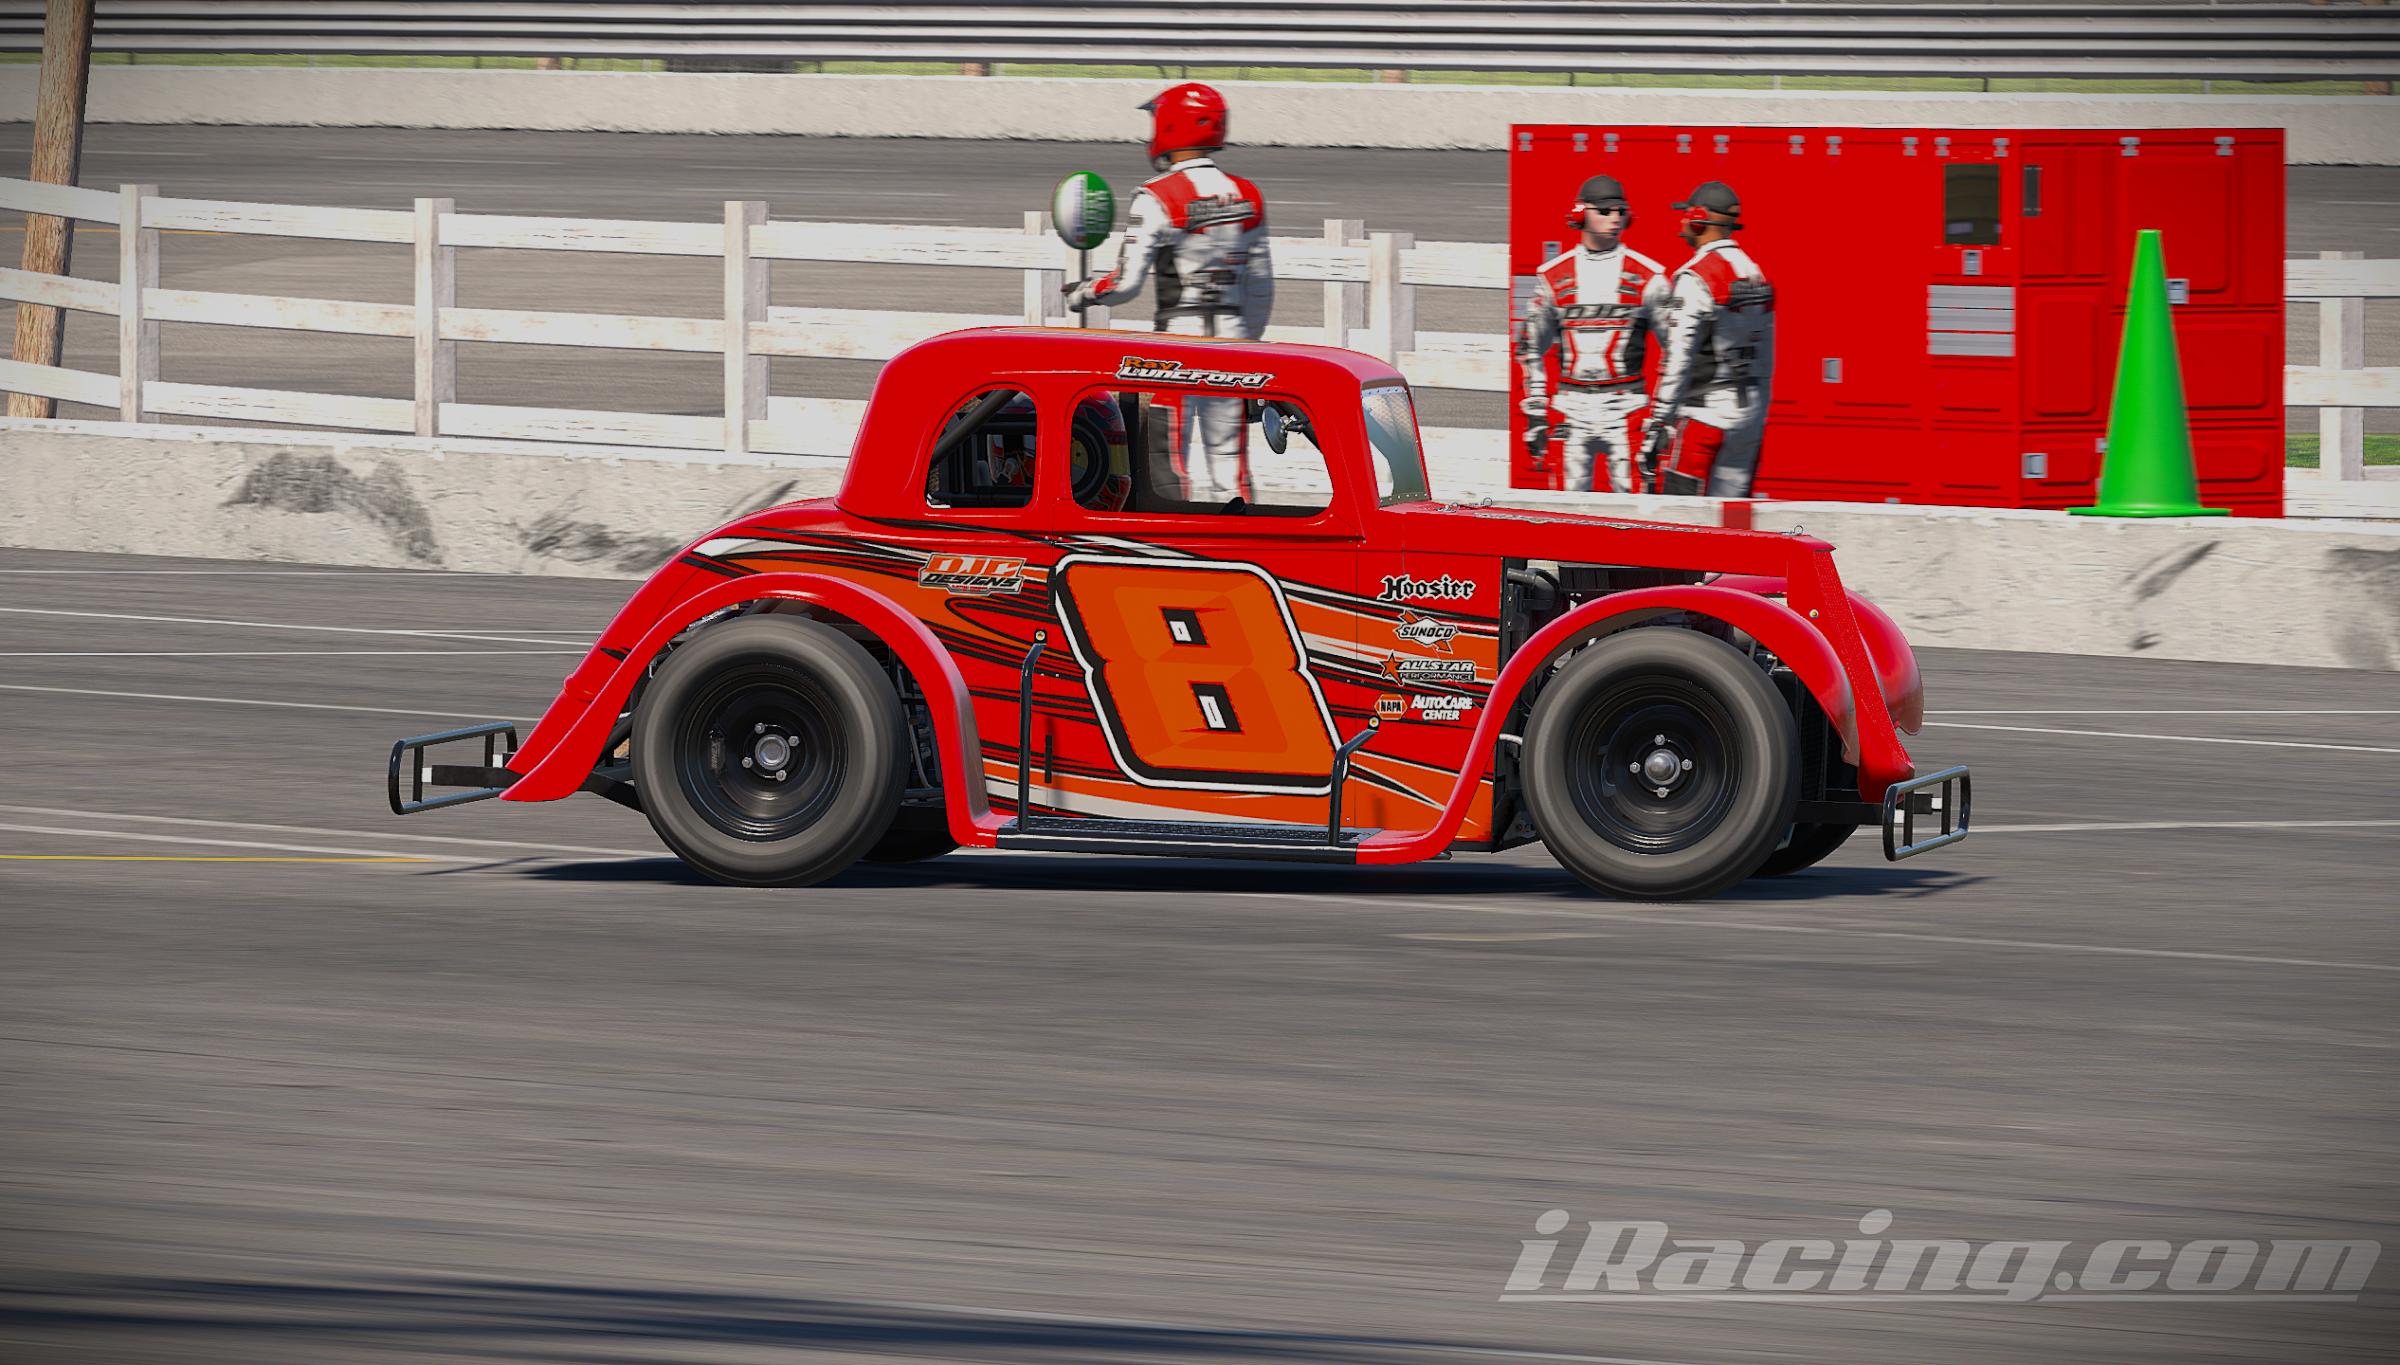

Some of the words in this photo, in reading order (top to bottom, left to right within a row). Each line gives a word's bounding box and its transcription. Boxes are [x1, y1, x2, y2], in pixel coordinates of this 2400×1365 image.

[1124, 357, 1176, 370] Ray
[921, 572, 1021, 588] DESIGNS
[1377, 574, 1476, 600] Hoosier
[1401, 625, 1454, 638] SUNOCO
[1398, 660, 1474, 671] ALLSTAR
[1056, 554, 1348, 794] 8
[1400, 672, 1473, 682] PERFORMANCE
[1380, 700, 1402, 713] NAPA
[1422, 709, 1460, 721] CENTER
